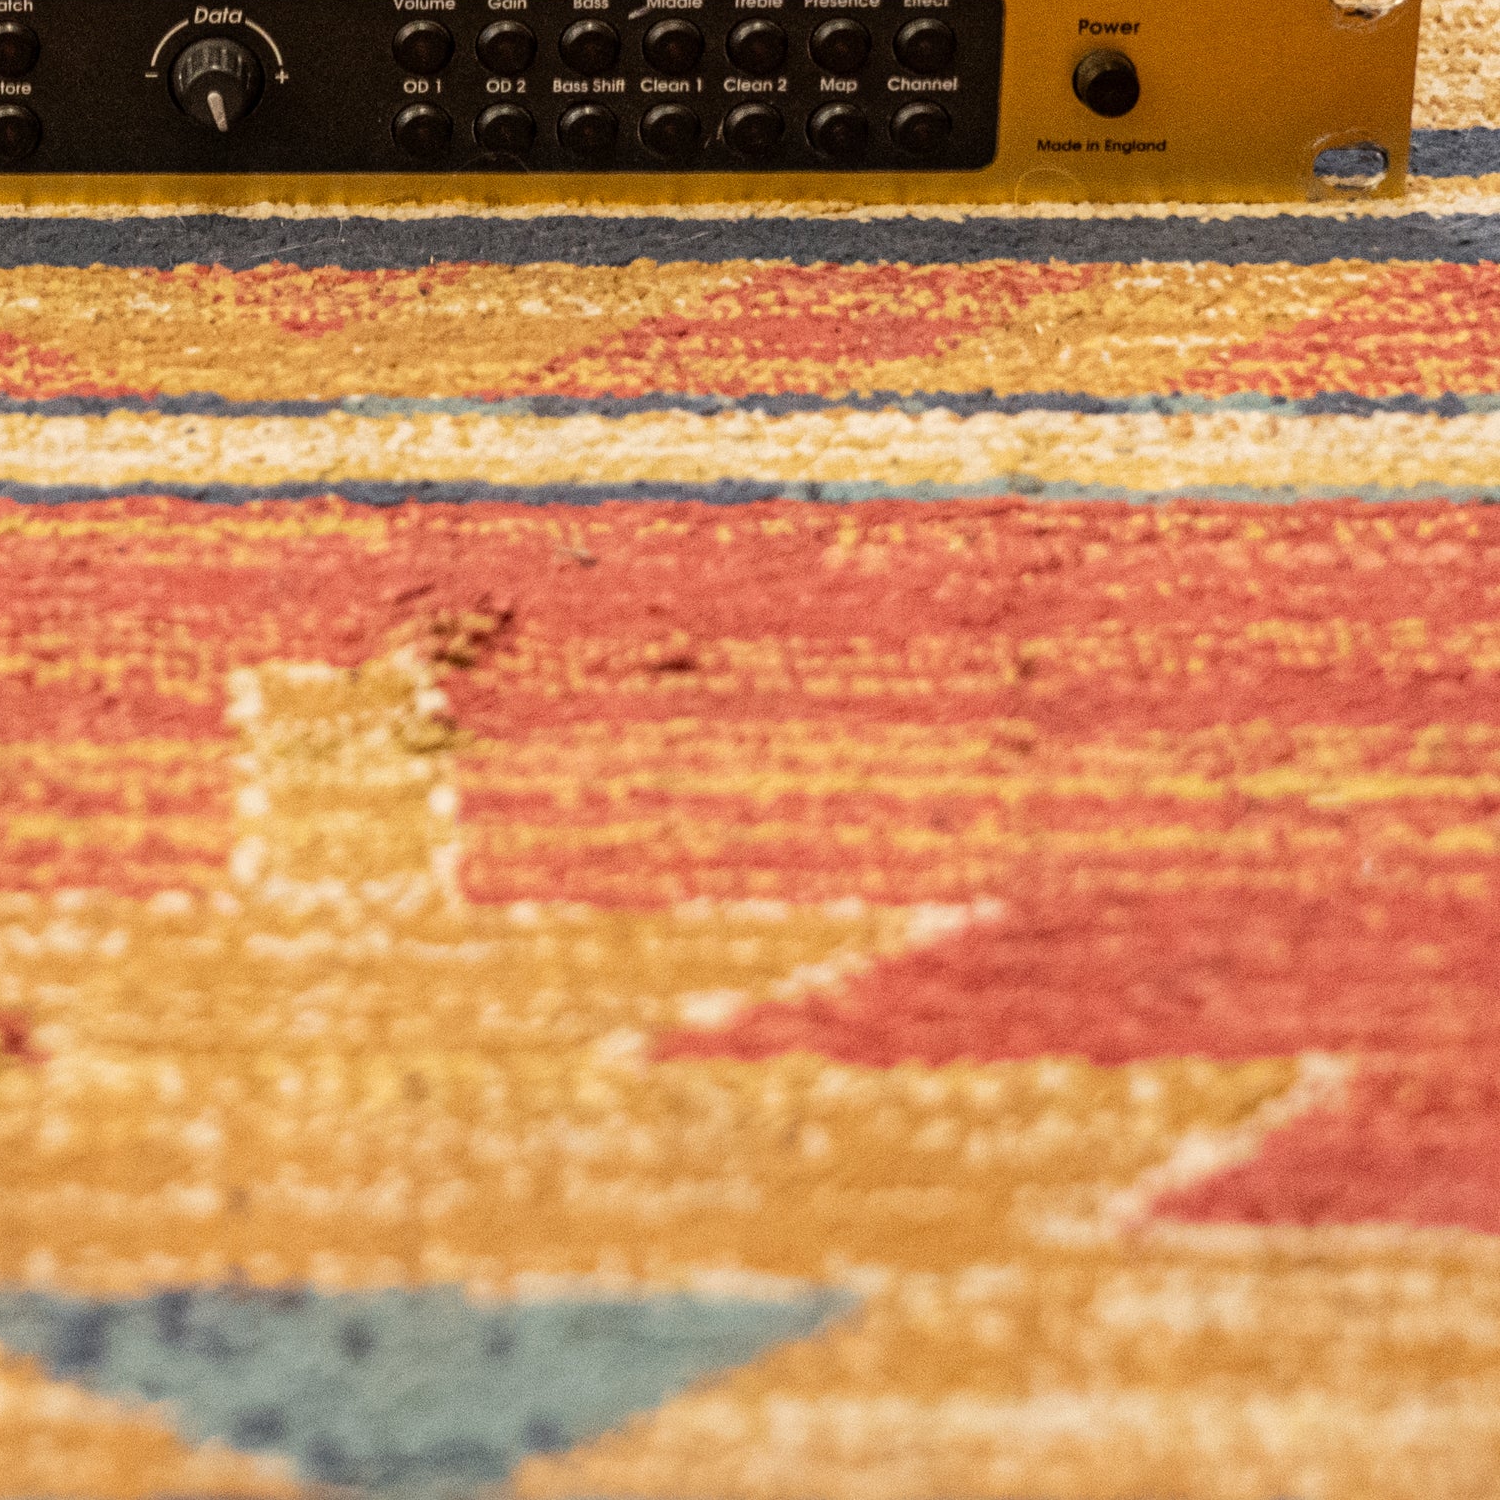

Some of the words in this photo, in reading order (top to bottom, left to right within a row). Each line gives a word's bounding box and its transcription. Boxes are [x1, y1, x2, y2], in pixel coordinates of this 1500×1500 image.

[194, 6, 243, 25] Data
[1078, 18, 1141, 36] Power
[403, 79, 429, 94] OD
[435, 79, 442, 94] 1
[486, 79, 512, 94] OD
[516, 79, 526, 94] 2
[552, 79, 588, 93] Bass
[593, 78, 626, 93] Shift
[640, 79, 690, 93] Clean
[696, 78, 702, 93] 1
[723, 78, 773, 92] Clean
[777, 78, 787, 92] 2
[820, 78, 858, 94] Map
[887, 77, 958, 92] Channel
[1037, 140, 1082, 153] Made
[1086, 139, 1100, 153] in
[1104, 139, 1167, 155] England
